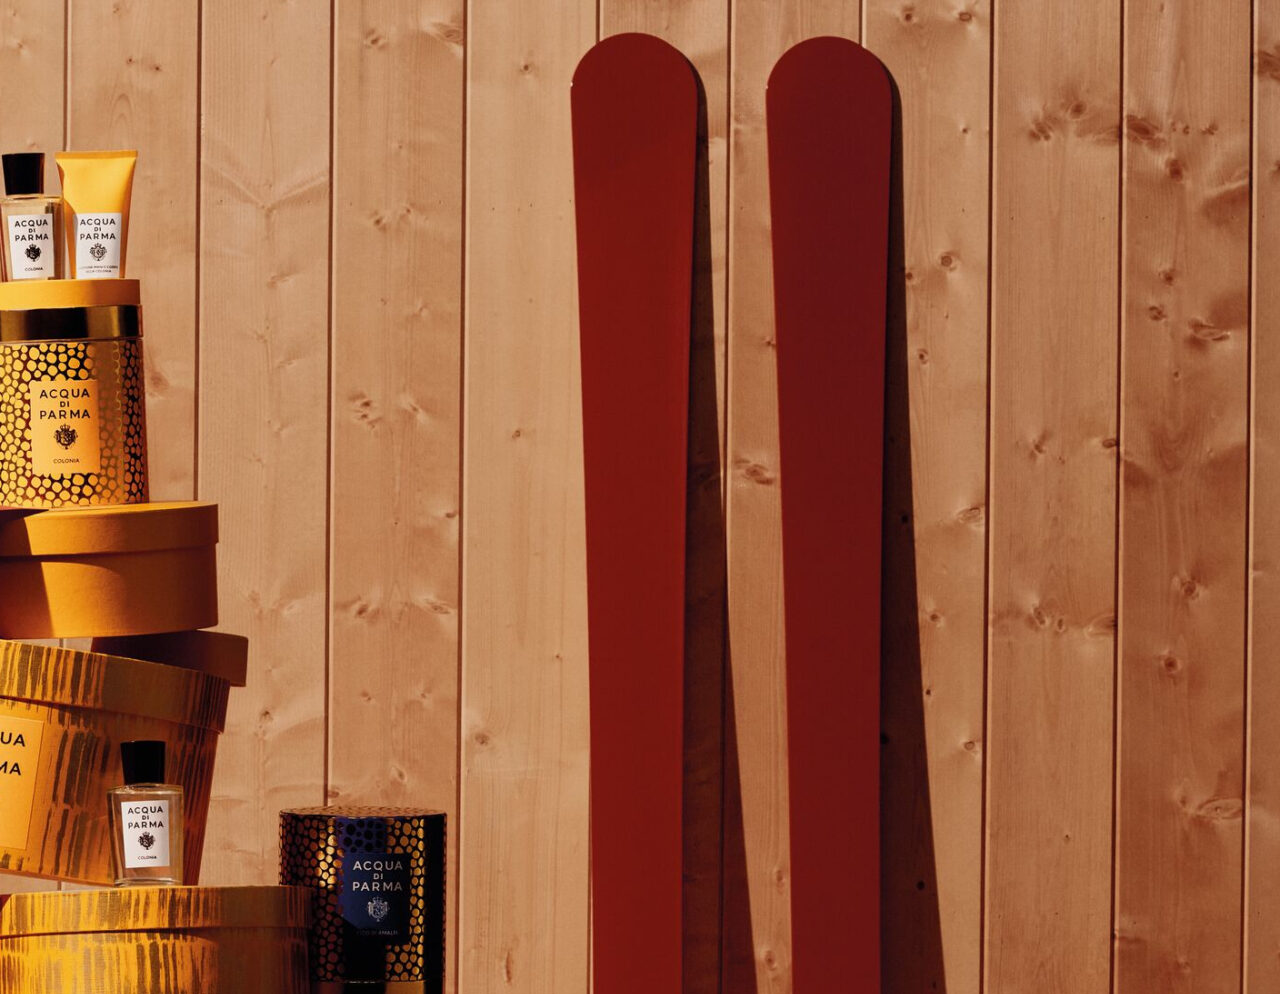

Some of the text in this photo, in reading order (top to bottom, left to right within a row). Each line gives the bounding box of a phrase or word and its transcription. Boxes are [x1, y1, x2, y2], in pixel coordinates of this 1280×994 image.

[14, 219, 48, 227] ACQUA
[80, 218, 116, 226] ACQUA
[15, 234, 49, 242] PARMA
[80, 232, 116, 241] PARMA
[40, 388, 90, 399] ACQUA
[40, 409, 90, 420] PARMA
[127, 806, 163, 814] ACQUA
[128, 821, 164, 829] PARMA
[352, 860, 403, 871] ACQUA
[352, 881, 403, 892] PARMA
